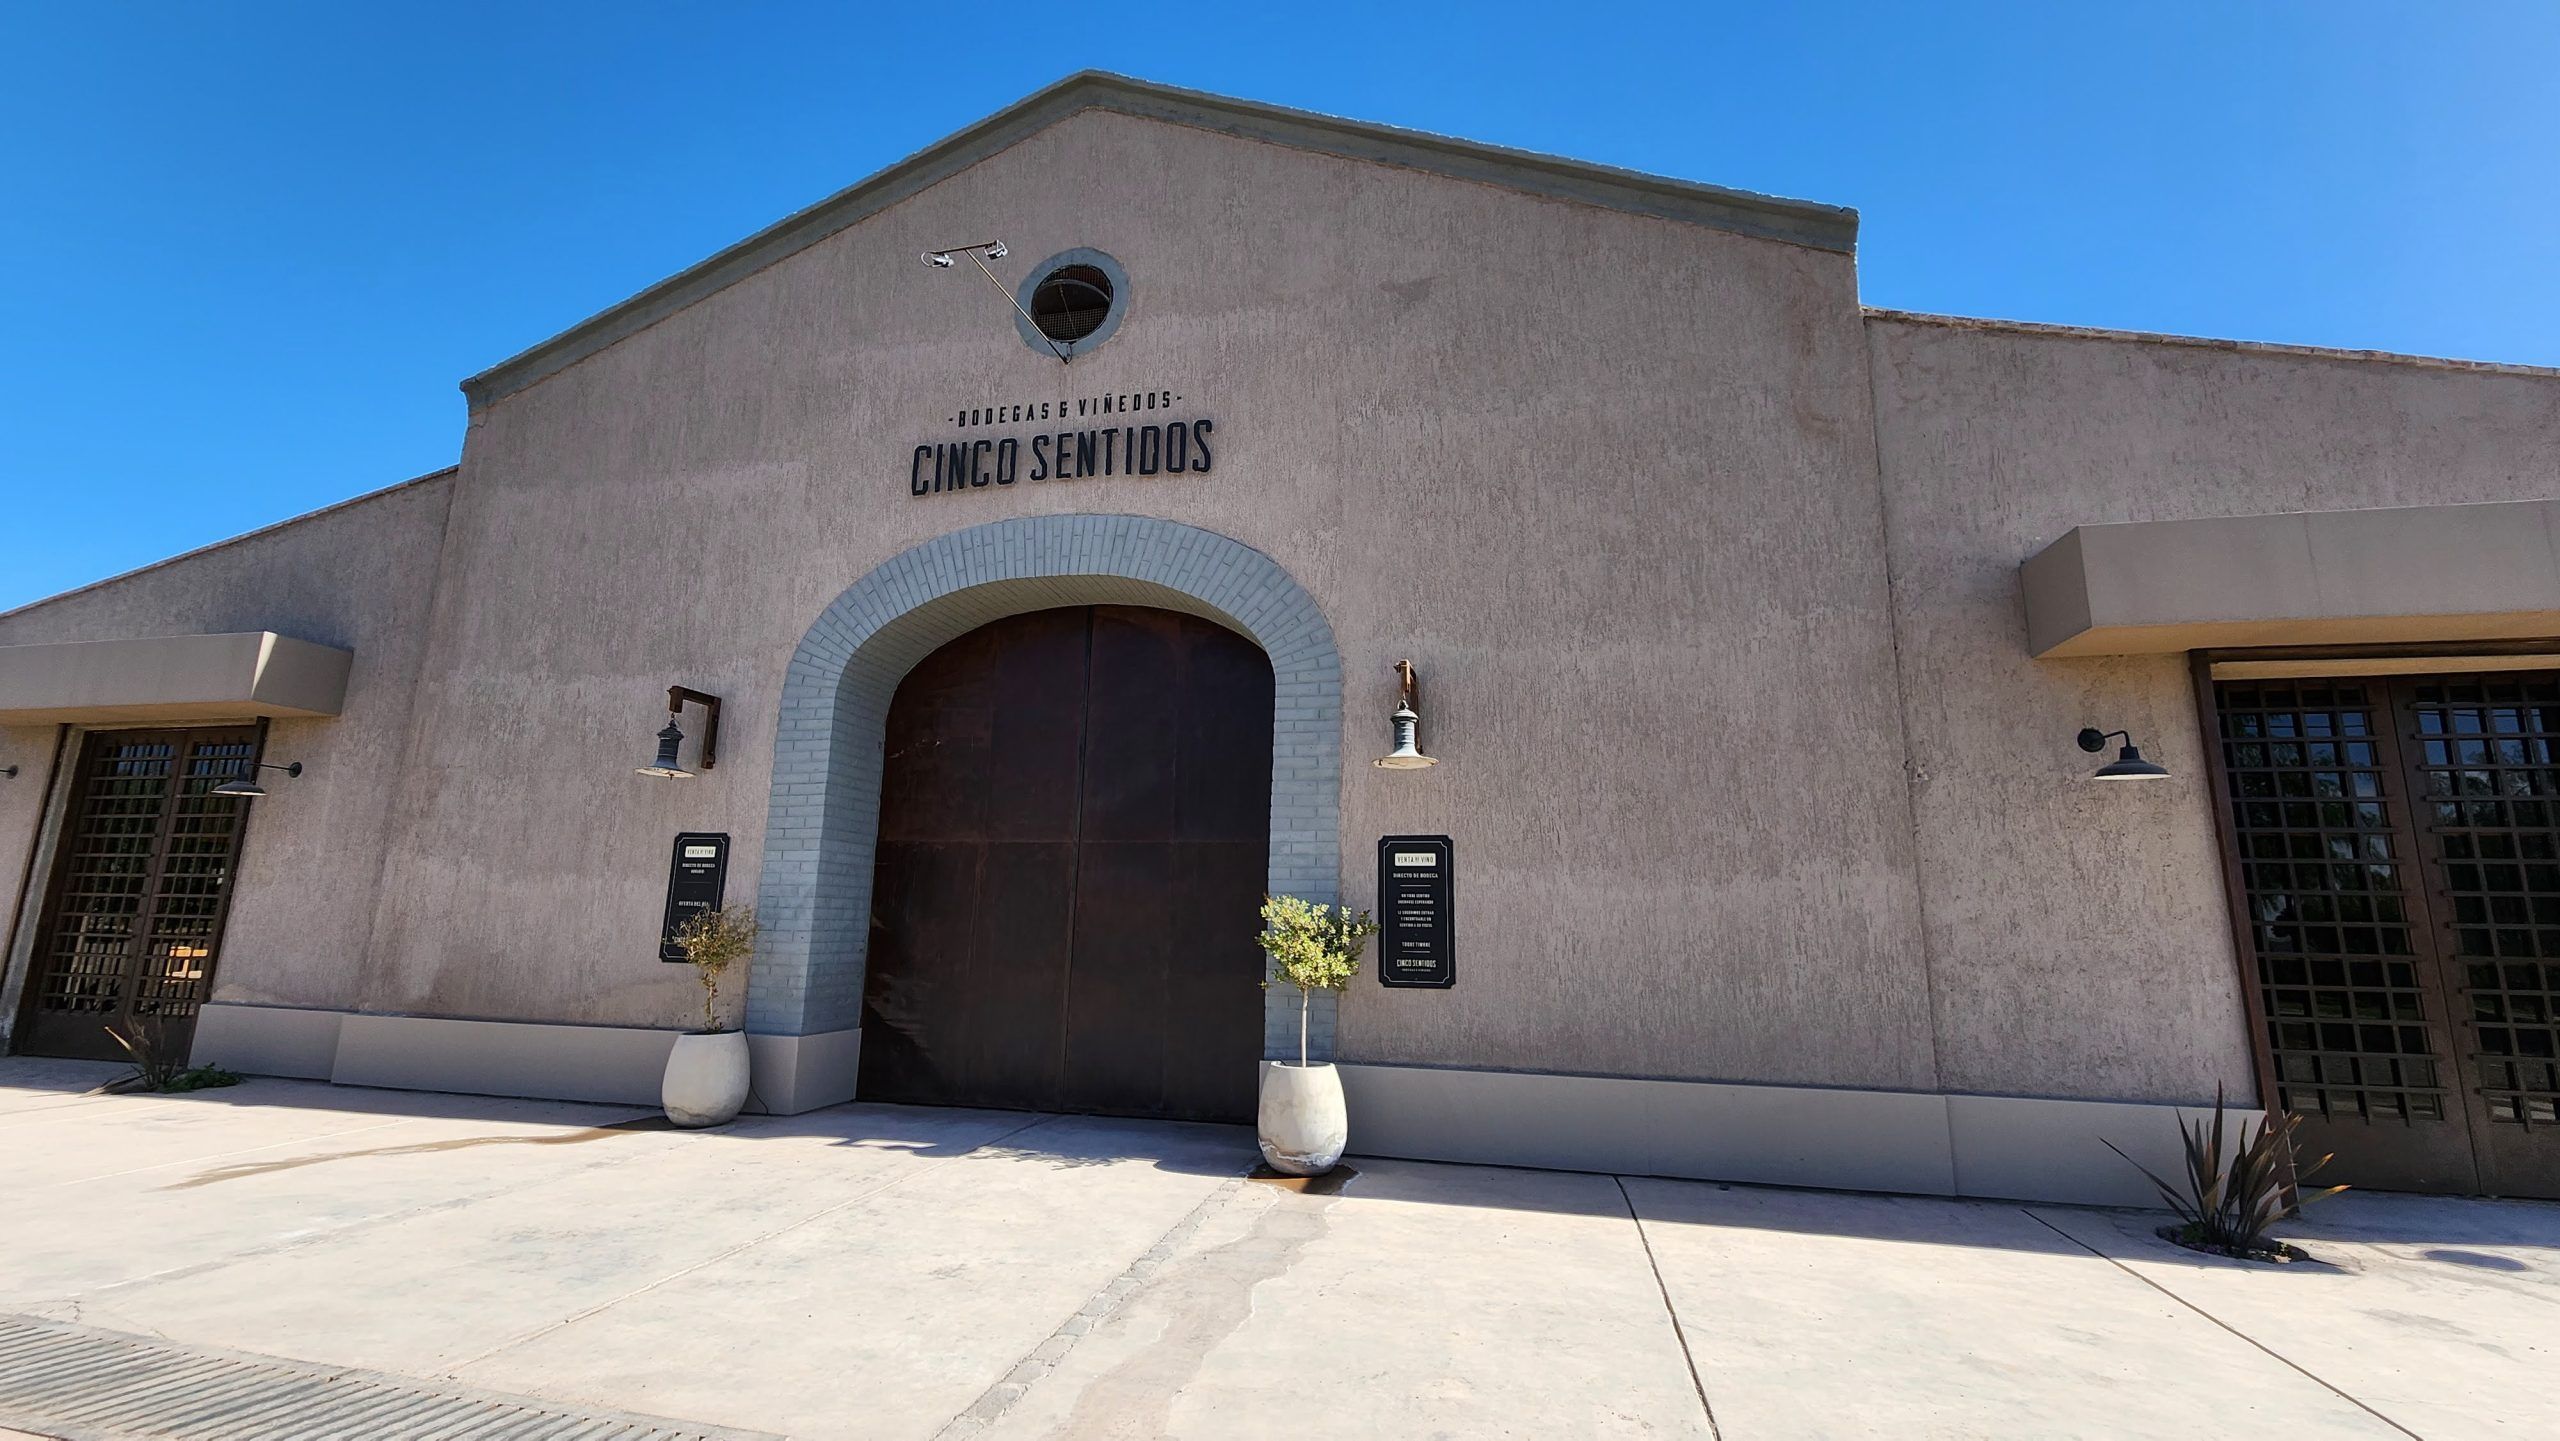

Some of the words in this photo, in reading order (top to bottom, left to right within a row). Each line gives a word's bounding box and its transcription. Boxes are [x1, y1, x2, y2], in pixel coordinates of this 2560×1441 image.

[1059, 400, 1069, 418] &
[911, 437, 1018, 497] CINCO
[1029, 419, 1214, 481] SENTIDOS
[1397, 856, 1414, 864] VENTA
[1420, 856, 1434, 864] VINO
[1397, 958, 1412, 968] CINCO
[1412, 959, 1437, 968] SENTIDOS
